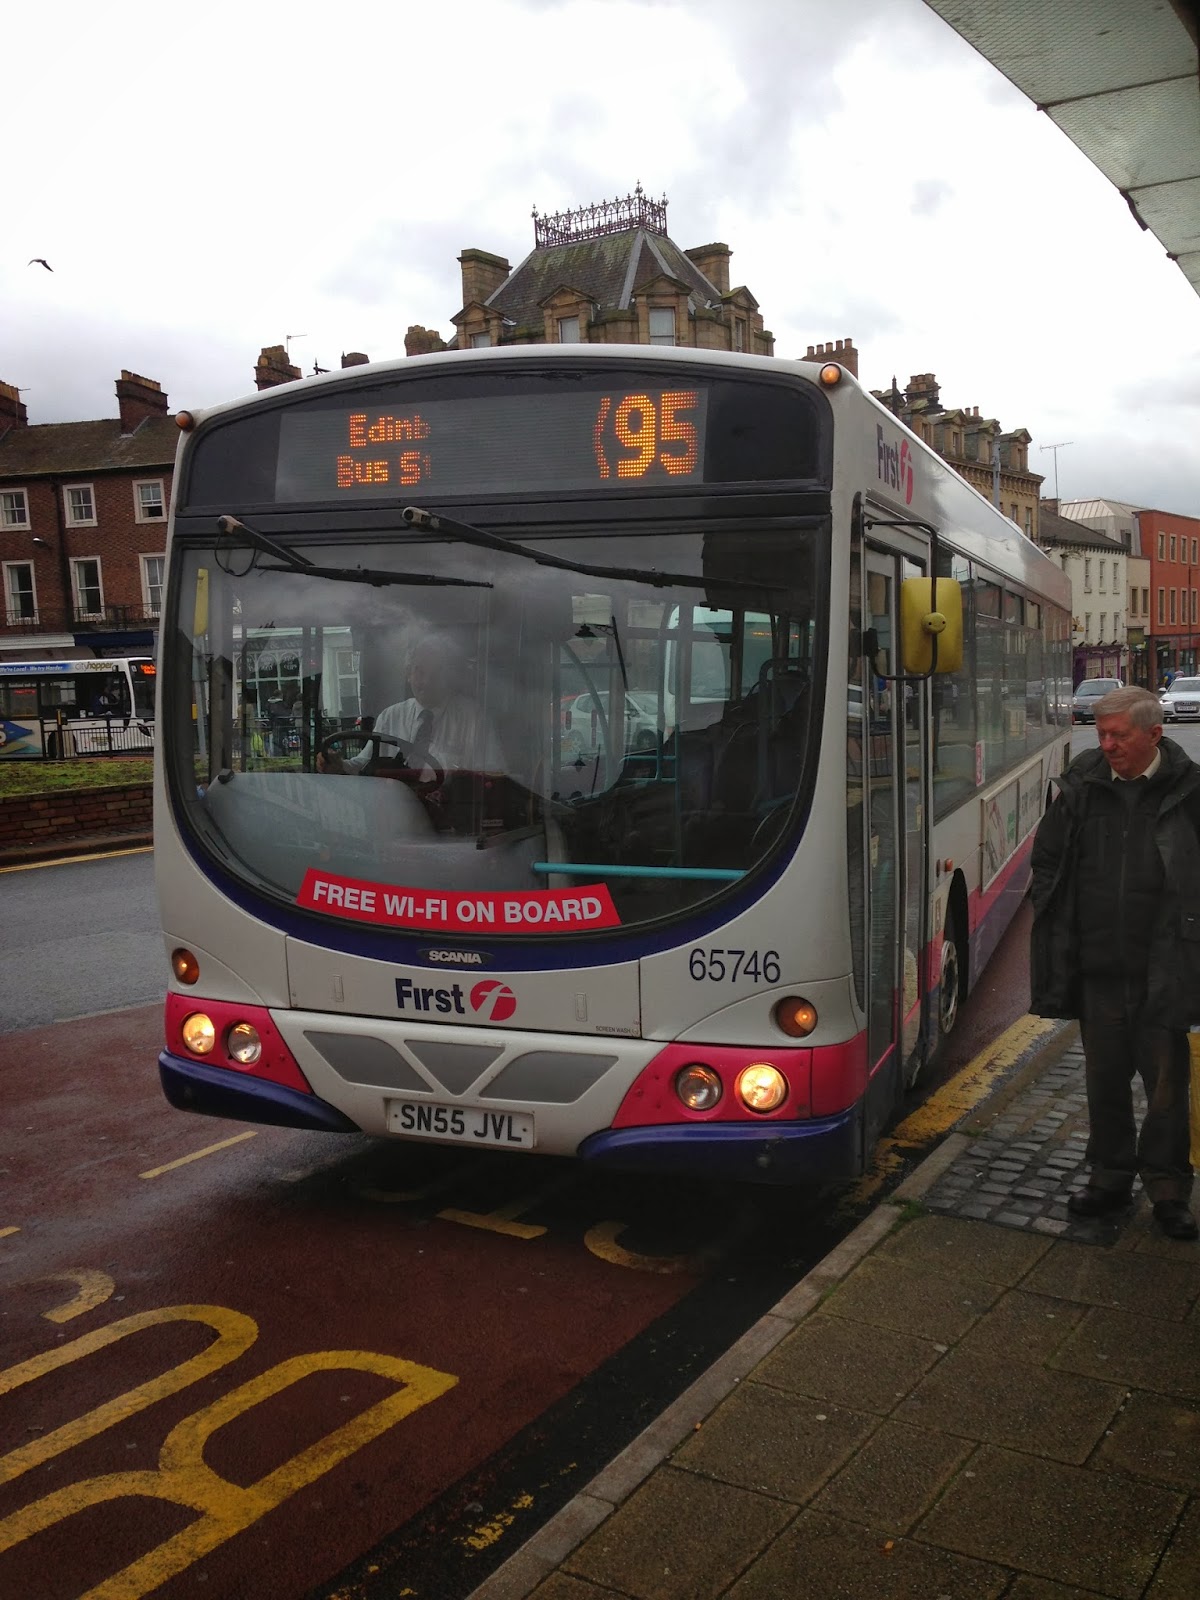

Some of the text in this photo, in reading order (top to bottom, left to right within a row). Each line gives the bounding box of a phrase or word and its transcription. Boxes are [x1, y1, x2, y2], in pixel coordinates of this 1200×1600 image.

[337, 455, 388, 488] Bus
[876, 423, 900, 491] First
[313, 880, 602, 924] FREE WI-FI ON BOARD
[429, 950, 482, 964] SCANIA
[689, 948, 781, 983] 65746
[395, 977, 465, 1014] First
[401, 1104, 522, 1142] SN55 JVL
